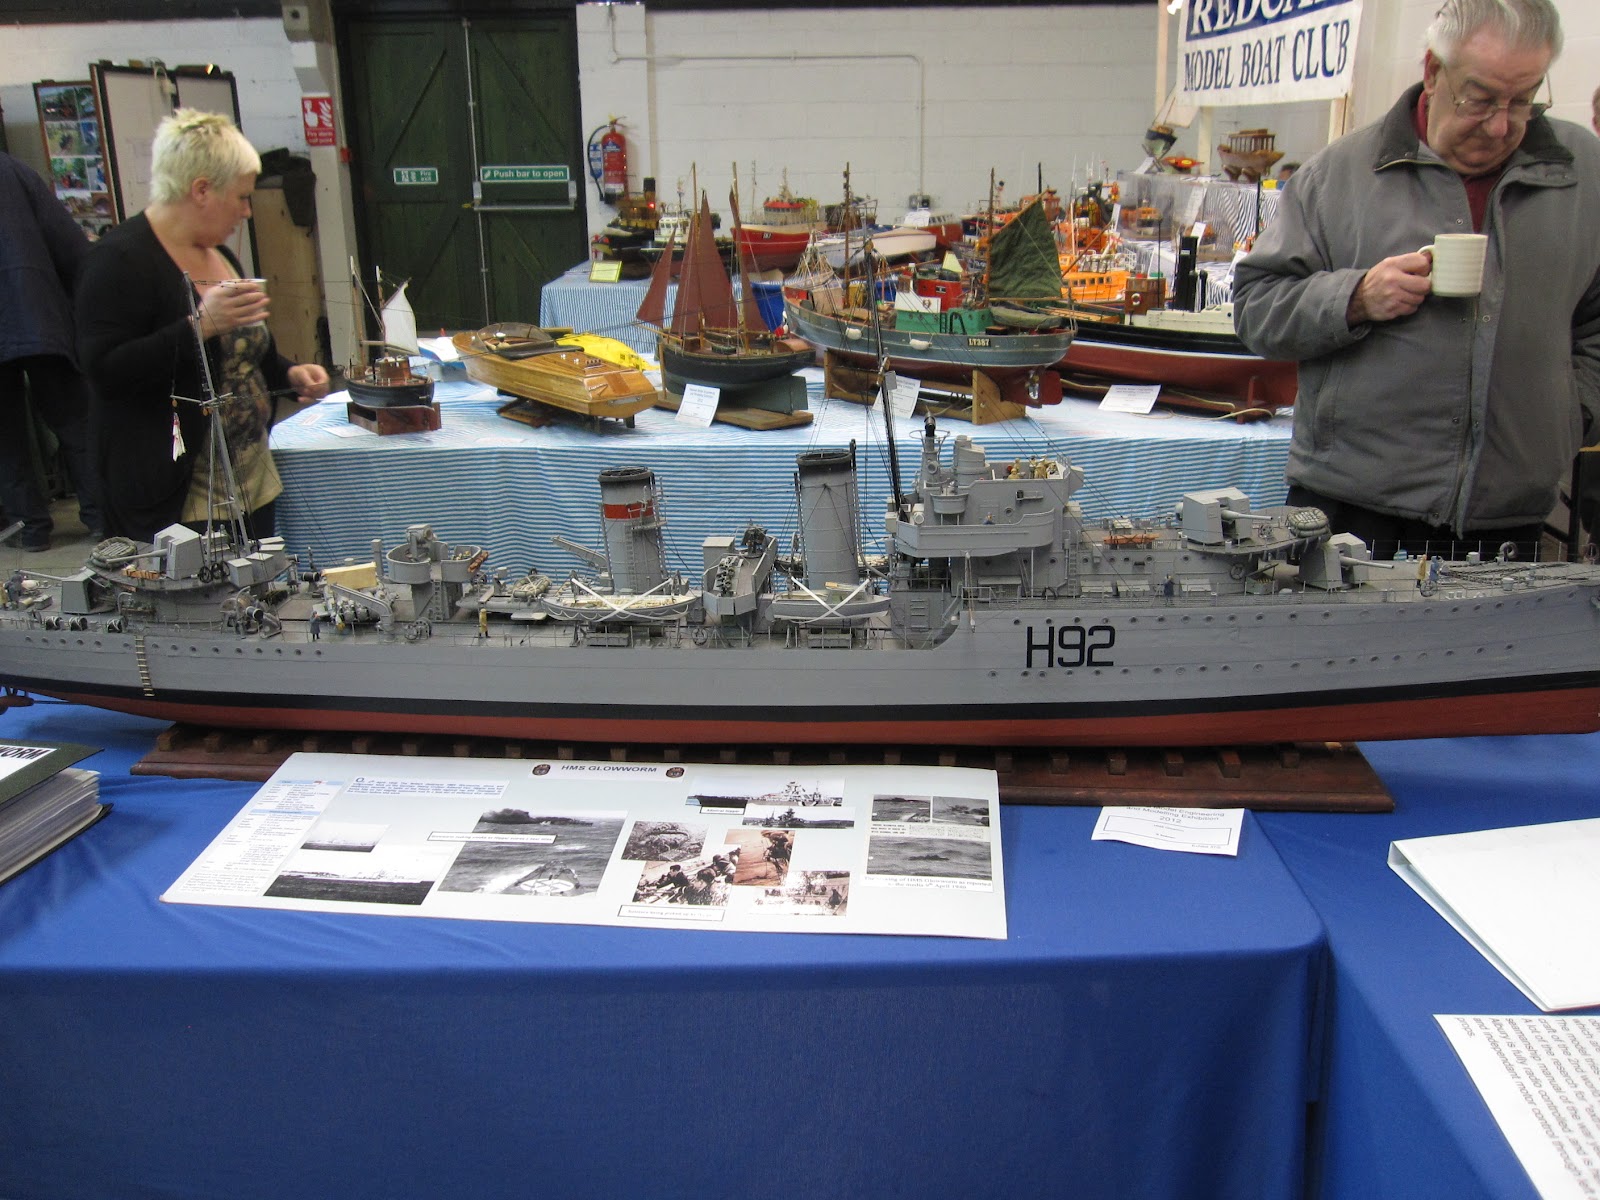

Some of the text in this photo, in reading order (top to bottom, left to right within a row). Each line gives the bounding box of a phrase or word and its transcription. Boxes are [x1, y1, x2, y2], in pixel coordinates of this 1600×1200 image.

[1184, 19, 1350, 92] MODEL BOAT CLUB
[493, 169, 564, 179] Push bar to open
[1026, 626, 1116, 668] H92
[588, 765, 657, 773] GLOWWORM
[1160, 816, 1182, 824] 2012
[1179, 808, 1225, 817] Engineering
[1181, 813, 1219, 821] Exhibition
[1454, 1016, 1476, 1039] props.
[1527, 1024, 1541, 1034] lot
[1538, 1018, 1557, 1034] craft
[1572, 1018, 1594, 1039] which
[1505, 1017, 1541, 1061] seamanship
[1535, 1034, 1549, 1043] of
[1551, 1034, 1564, 1043] of
[1541, 1044, 1555, 1057] the
[1555, 1018, 1600, 1075] The model tries
[1557, 1044, 1572, 1057] the
[1551, 1057, 1578, 1088] reserch
[1567, 1058, 1587, 1073] 2nd
[1489, 1017, 1511, 1045] Albury
[1506, 1040, 1516, 1048] is
[1512, 1049, 1528, 1069] fully
[1523, 1066, 1542, 1088] radio
[1538, 1089, 1574, 1133] controlled
[1538, 1062, 1566, 1094] manual
[1473, 1017, 1489, 1031] and
[1484, 1031, 1521, 1080] independant
[1515, 1080, 1537, 1106] motor
[1531, 1107, 1560, 1139] control
[1552, 1140, 1582, 1177] through
[1559, 1094, 1574, 1104] of
[1573, 1090, 1588, 1102] for
[1566, 1105, 1580, 1120] the
